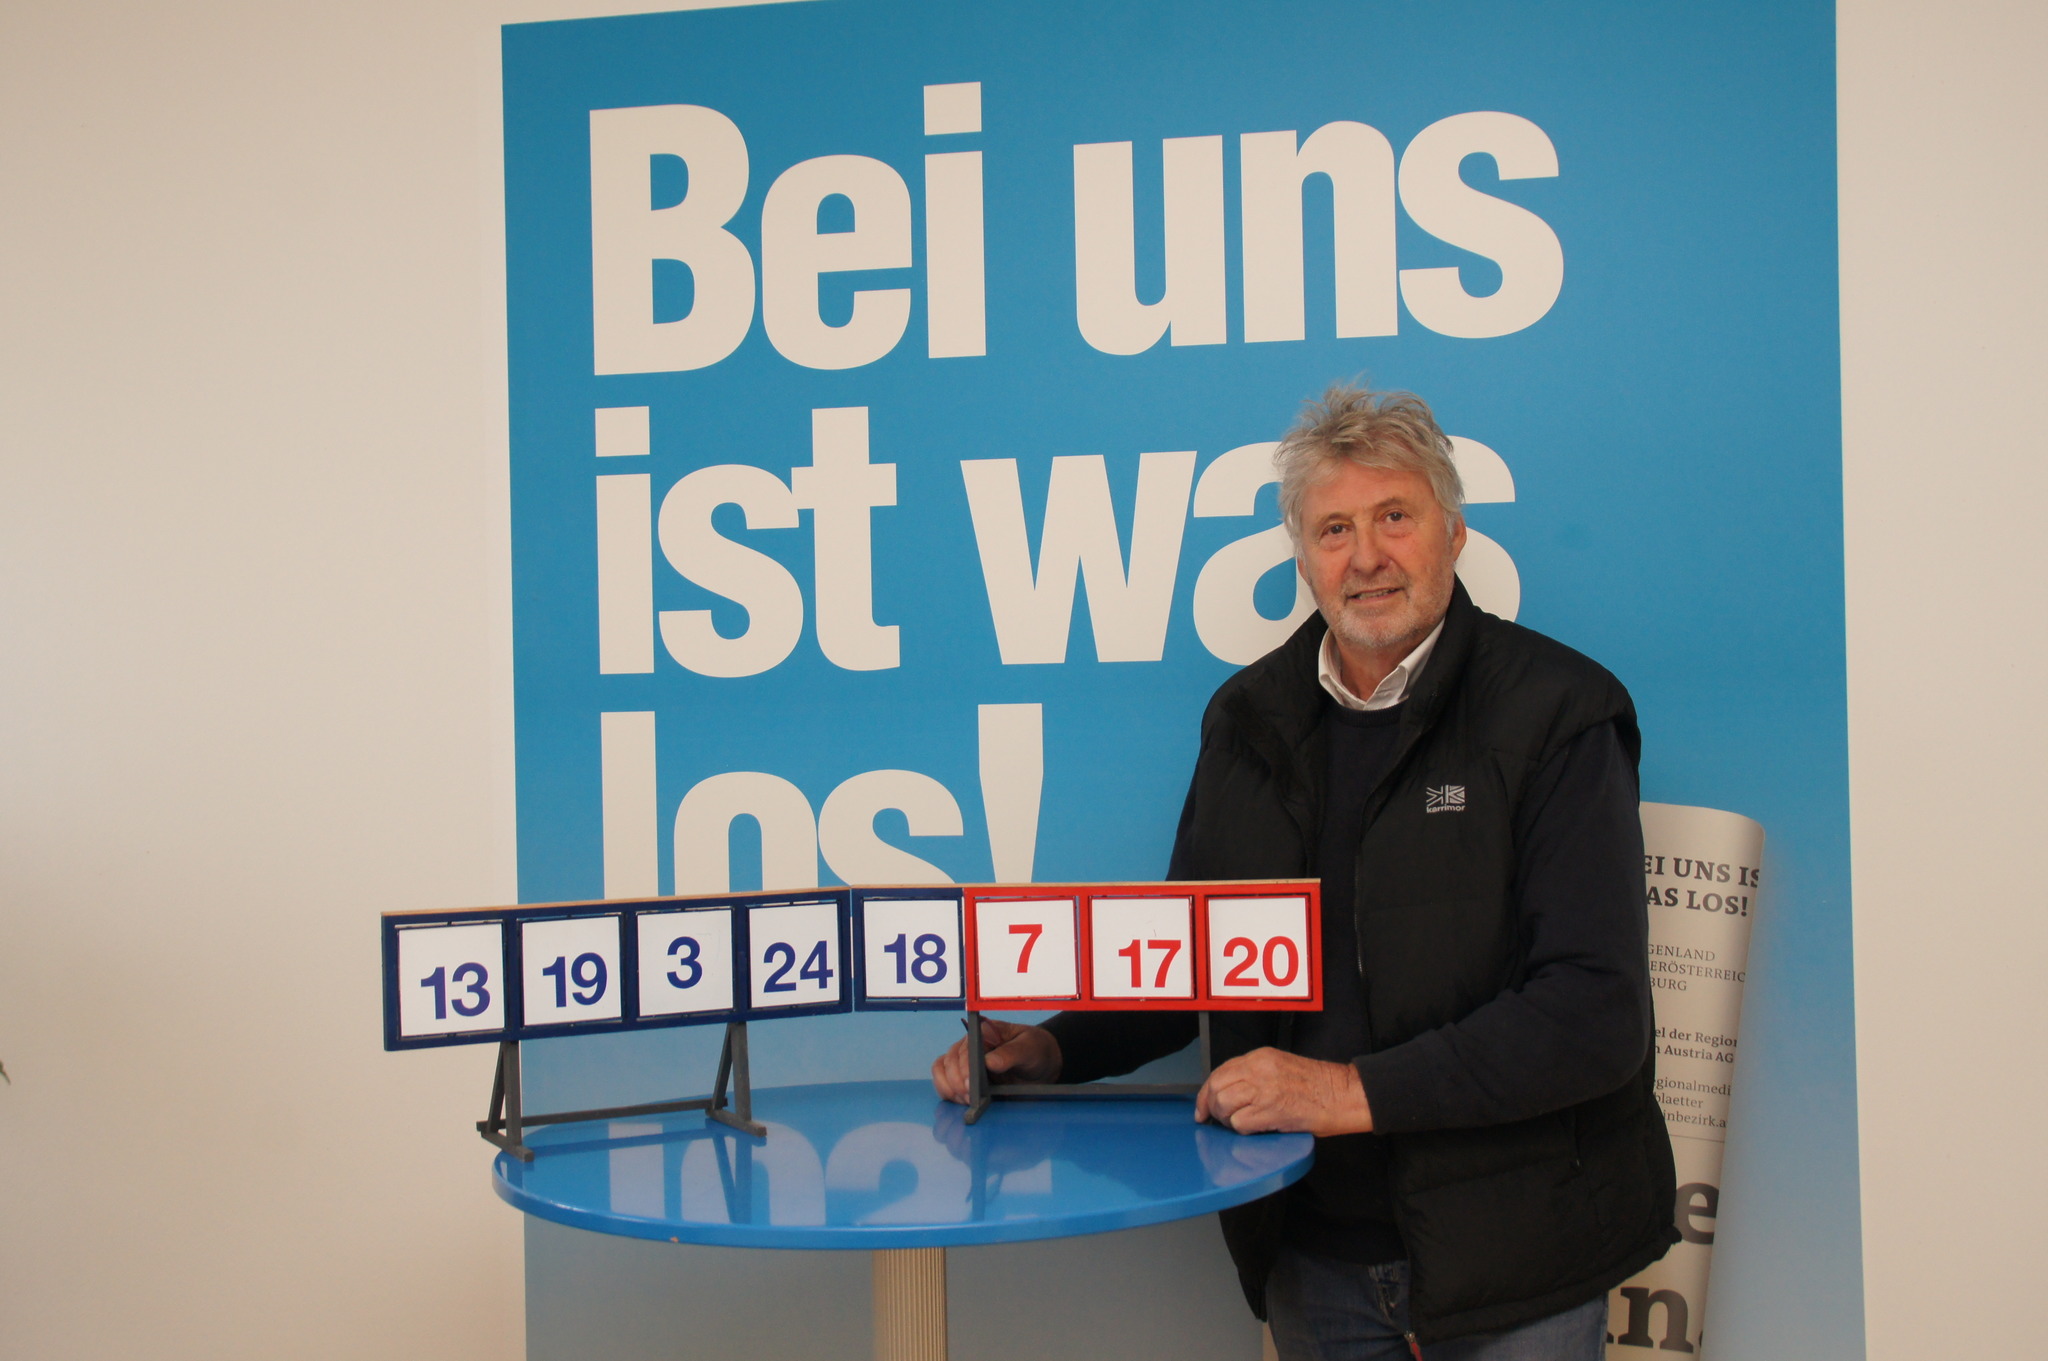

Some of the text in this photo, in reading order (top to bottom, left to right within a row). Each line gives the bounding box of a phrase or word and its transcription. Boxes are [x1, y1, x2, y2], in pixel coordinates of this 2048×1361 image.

[590, 82, 1564, 376] Bei uns
[595, 406, 901, 678] ist
[1426, 804, 1466, 813] karrimor
[1673, 857, 1731, 883] UNS
[1686, 890, 1749, 917] LOS!
[1008, 923, 1299, 988] 7 17 20
[420, 933, 948, 1020] 13 19 3 24 18
[1669, 1028, 1692, 1041] der
[1664, 1044, 1713, 1061] Austria
[1715, 1052, 1734, 1064] AG
[1654, 1076, 1732, 1096] gionalmedi
